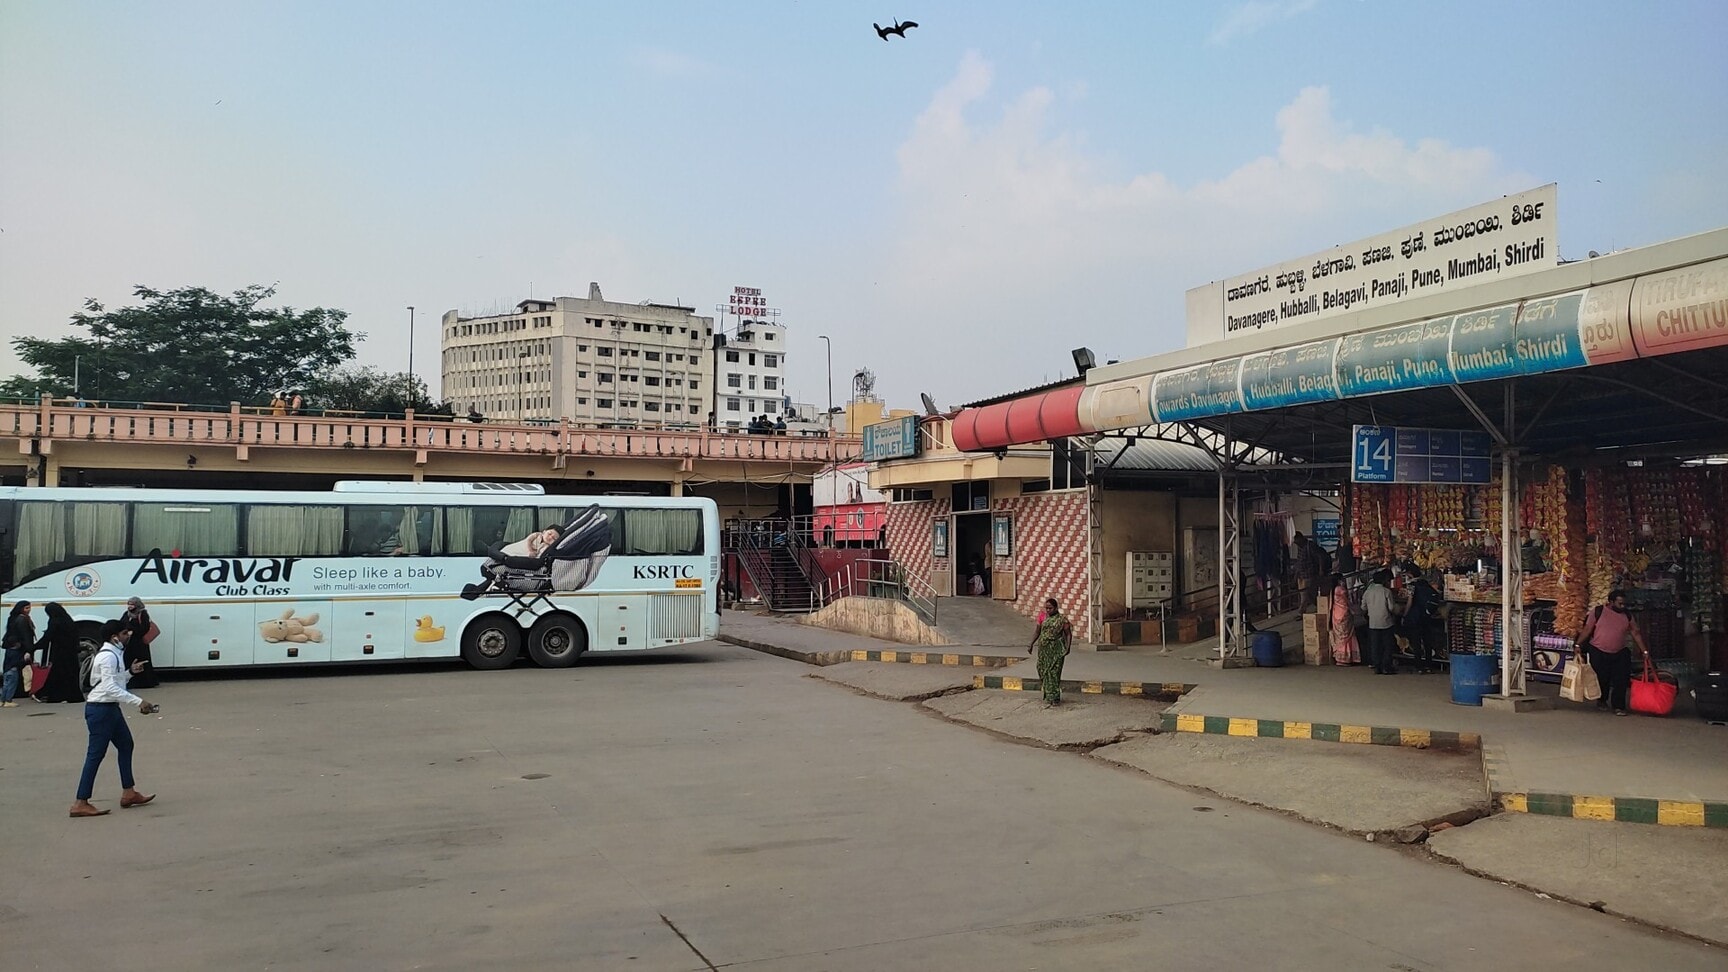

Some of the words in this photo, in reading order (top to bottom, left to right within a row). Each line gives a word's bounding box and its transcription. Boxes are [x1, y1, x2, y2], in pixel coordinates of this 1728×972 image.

[734, 286, 761, 296] HOTEL
[1228, 308, 1278, 332] Davanagere,
[1280, 294, 1320, 319] Hubballi,
[1323, 282, 1368, 309] Belagavi,
[1372, 273, 1408, 298] Panaji,
[1412, 268, 1444, 289] Pune,
[1448, 249, 1500, 280] Mumbai,
[1505, 237, 1544, 266] Shirdi
[731, 306, 767, 317] LODGE
[1355, 361, 1401, 385] Panaji,
[1516, 333, 1568, 360] Shirdi
[875, 440, 901, 457] TOILET
[1358, 437, 1392, 471] 14
[1358, 472, 1387, 480] Platform
[313, 566, 357, 580] Sleep
[363, 566, 388, 578] like
[394, 568, 402, 578] a
[408, 566, 446, 579] baby.
[633, 565, 694, 579] KSRTC
[215, 585, 248, 597] Club
[252, 584, 291, 596] Class
[313, 583, 331, 591] with
[334, 583, 376, 591] multi-axle
[378, 582, 412, 590] comfort.
